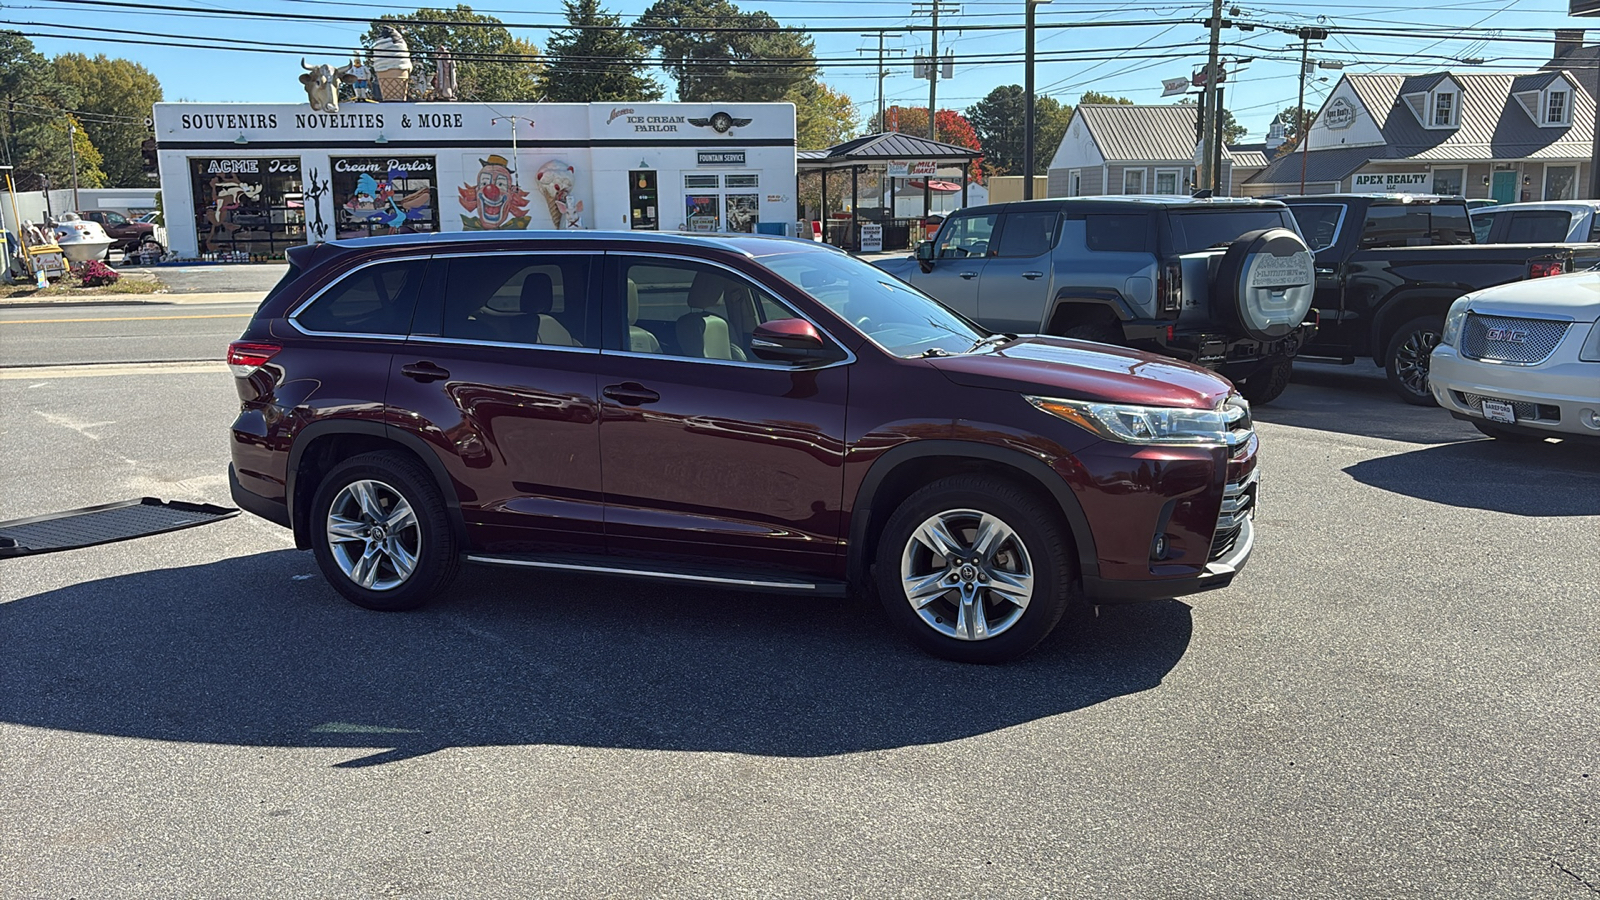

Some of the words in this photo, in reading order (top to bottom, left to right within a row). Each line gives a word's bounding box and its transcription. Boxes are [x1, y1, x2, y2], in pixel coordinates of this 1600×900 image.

[181, 114, 278, 129] SOUVENIRS
[295, 113, 385, 129] NOVELTIES
[401, 113, 412, 128] &
[418, 113, 463, 128] MORE
[626, 116, 644, 124] ICE
[646, 116, 686, 124] CREAM
[634, 124, 678, 132] PARLOR
[699, 154, 723, 162] FOUNTAIN
[723, 153, 744, 162] SERVICE
[207, 159, 260, 174] ACME
[268, 159, 299, 173] Ice
[334, 159, 381, 172] Cream
[386, 159, 434, 172] Parlor
[916, 160, 937, 168] MILK
[1356, 175, 1384, 185] APEX
[1386, 174, 1427, 184] REALTY
[1486, 328, 1528, 342] GMC
[1485, 402, 1511, 412] BAREFORD
